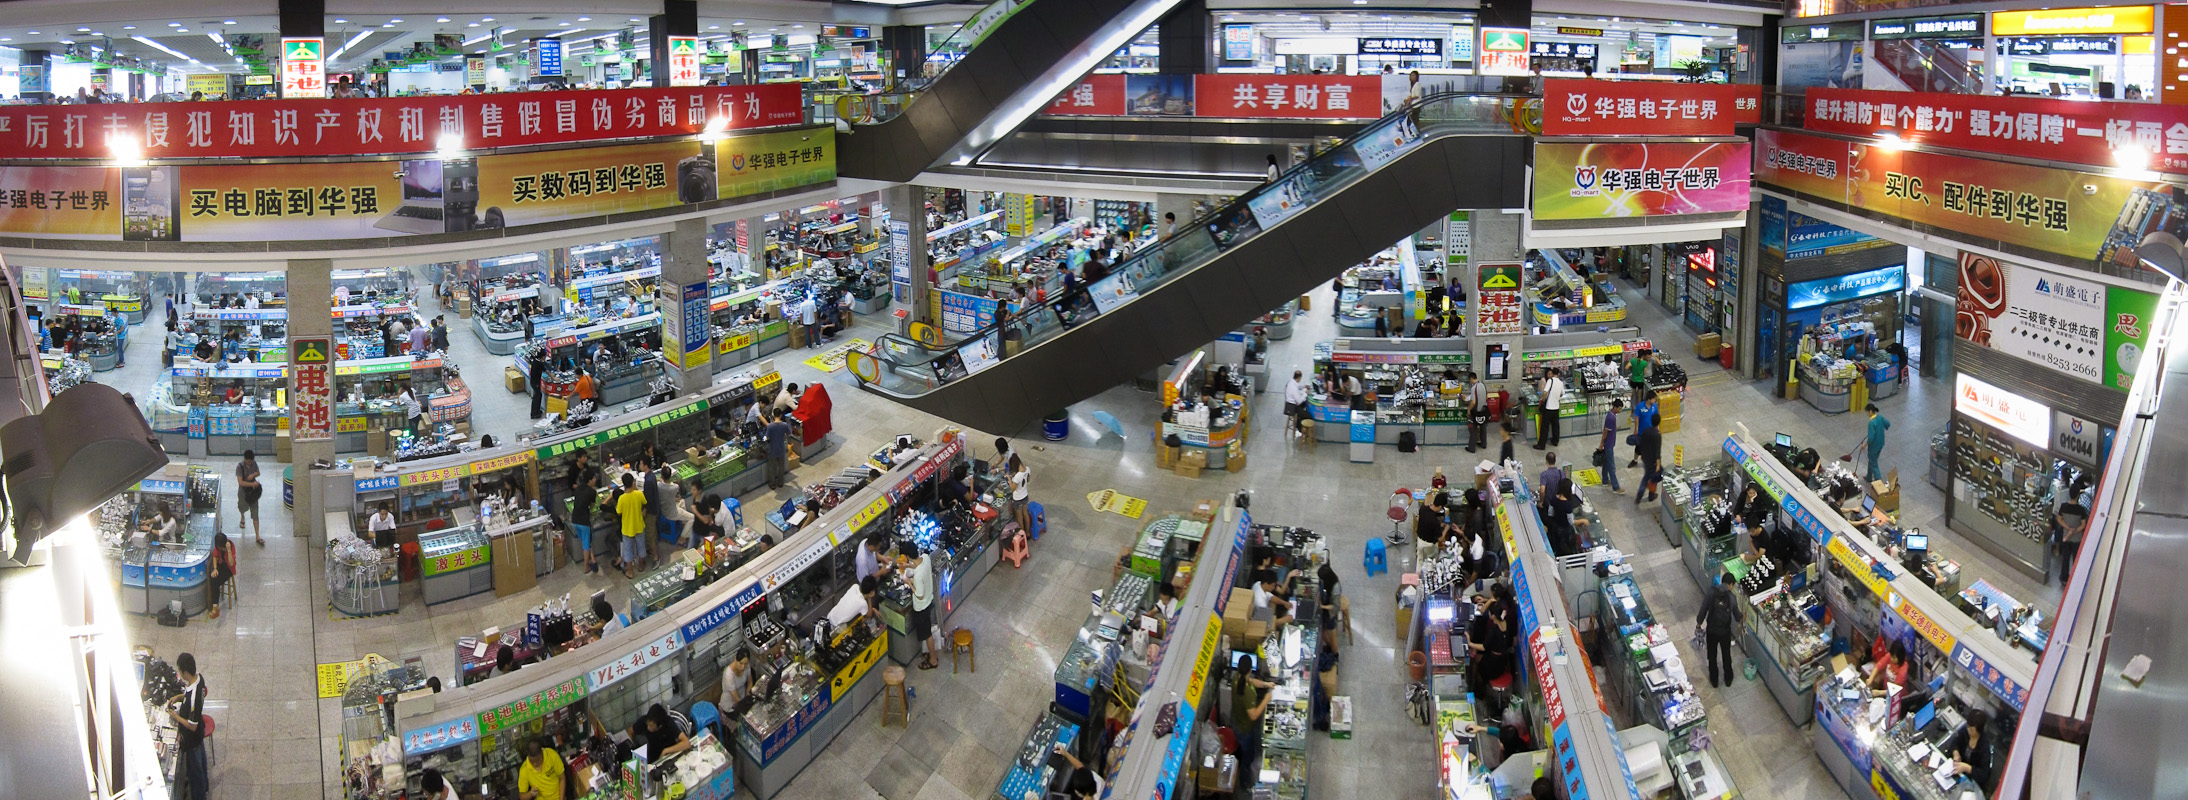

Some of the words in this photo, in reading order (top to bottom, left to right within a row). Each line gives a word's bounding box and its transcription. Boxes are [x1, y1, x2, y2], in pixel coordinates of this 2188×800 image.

[673, 55, 697, 80] 电池
[1481, 53, 1528, 69] 电池
[286, 63, 322, 89] 电池
[1232, 83, 1353, 111] 共享财富
[1594, 97, 1719, 121] 华强电子世界
[1734, 97, 1758, 111] 世界
[749, 146, 824, 171] 华强电子世界
[1777, 149, 1838, 179] 华强电子世界
[511, 162, 667, 203] 买数码到华强
[1601, 167, 1721, 192] 华强电子世界
[190, 186, 380, 218] 买电脑到华强
[1884, 170, 2070, 232] 买IC、配件到华强
[1477, 293, 1521, 324] 电池
[2010, 305, 2100, 340] 二三极管专业供应商
[2114, 313, 2142, 339] 思
[721, 342, 734, 352] 螺丝
[2047, 352, 2070, 371] 8253
[2073, 362, 2097, 378] 2666
[296, 365, 331, 430] 电池
[2059, 432, 2093, 458] Q1C044
[408, 466, 463, 485] 激光头总汇
[435, 549, 483, 572] 激光头
[482, 680, 575, 725] 电池电子系列
